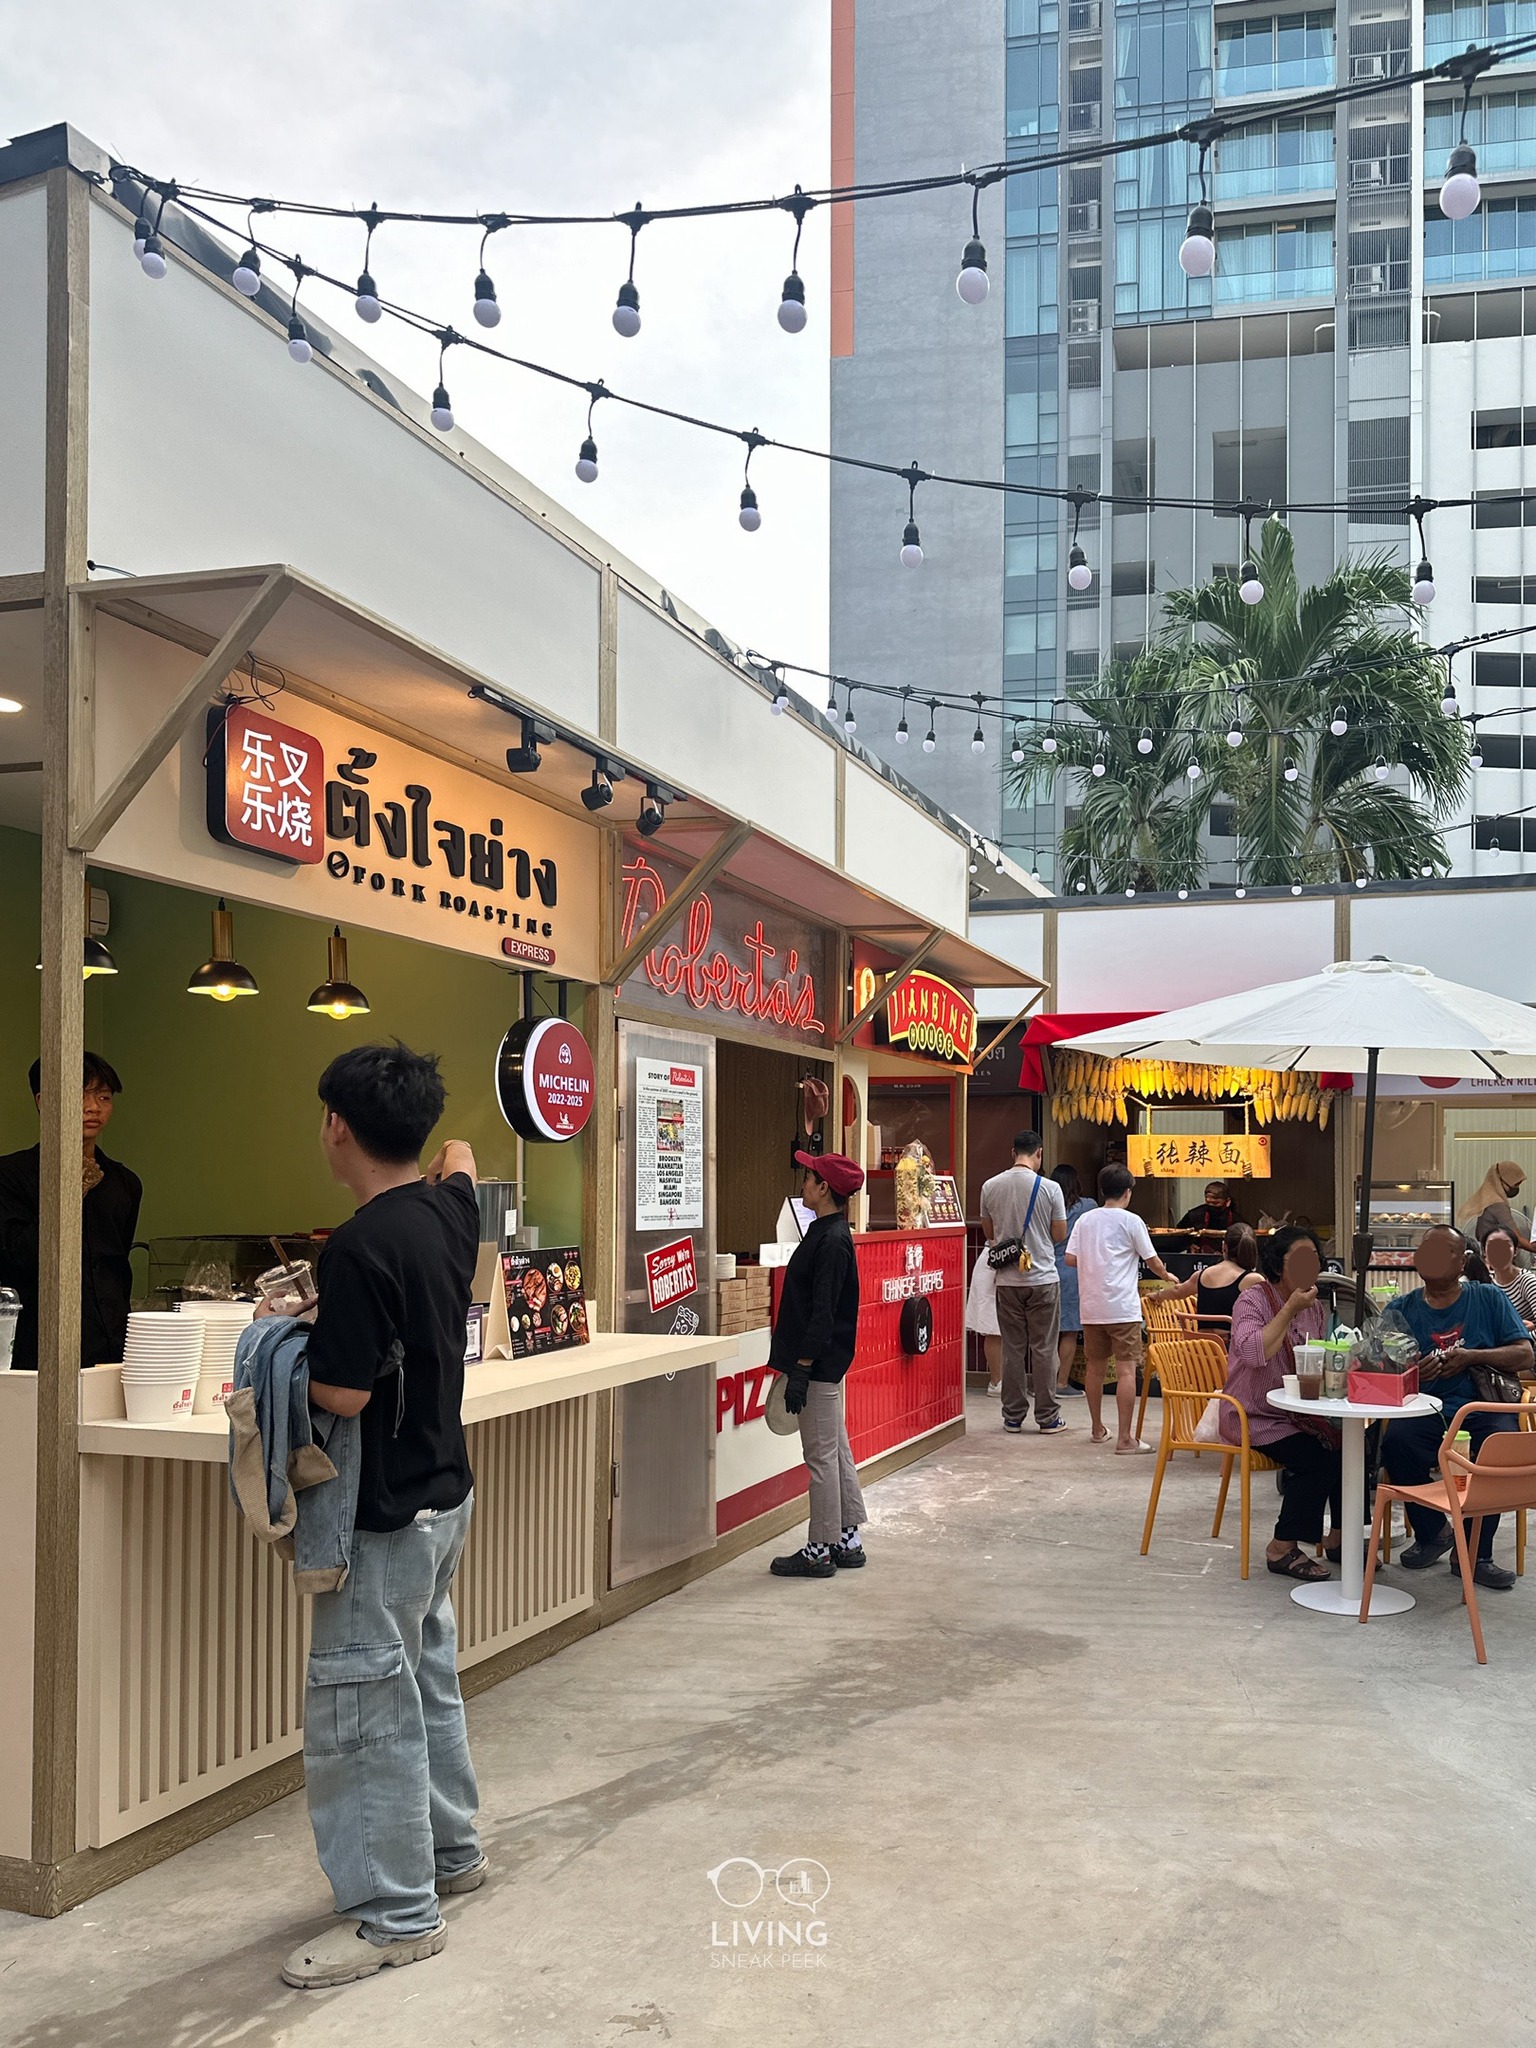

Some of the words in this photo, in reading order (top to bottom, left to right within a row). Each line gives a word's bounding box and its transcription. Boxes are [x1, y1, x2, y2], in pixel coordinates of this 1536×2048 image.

[326, 747, 558, 907] ตั้งใจย่าง
[439, 890, 553, 938] ROASTING
[510, 940, 550, 962] EXPRESS
[621, 856, 825, 1034] Roberta's
[909, 1025, 952, 1056] HOUSE
[539, 1073, 590, 1093] MICHELIN
[648, 1072, 663, 1080] STORY
[547, 1092, 583, 1107] 2022-2025
[651, 1255, 676, 1275] Sorry
[676, 1248, 690, 1264] We're
[990, 1244, 1018, 1263] Supre
[652, 1262, 694, 1305] ROBERTA'S
[883, 1275, 916, 1303] CHINESE
[716, 1365, 781, 1434] PIZ
